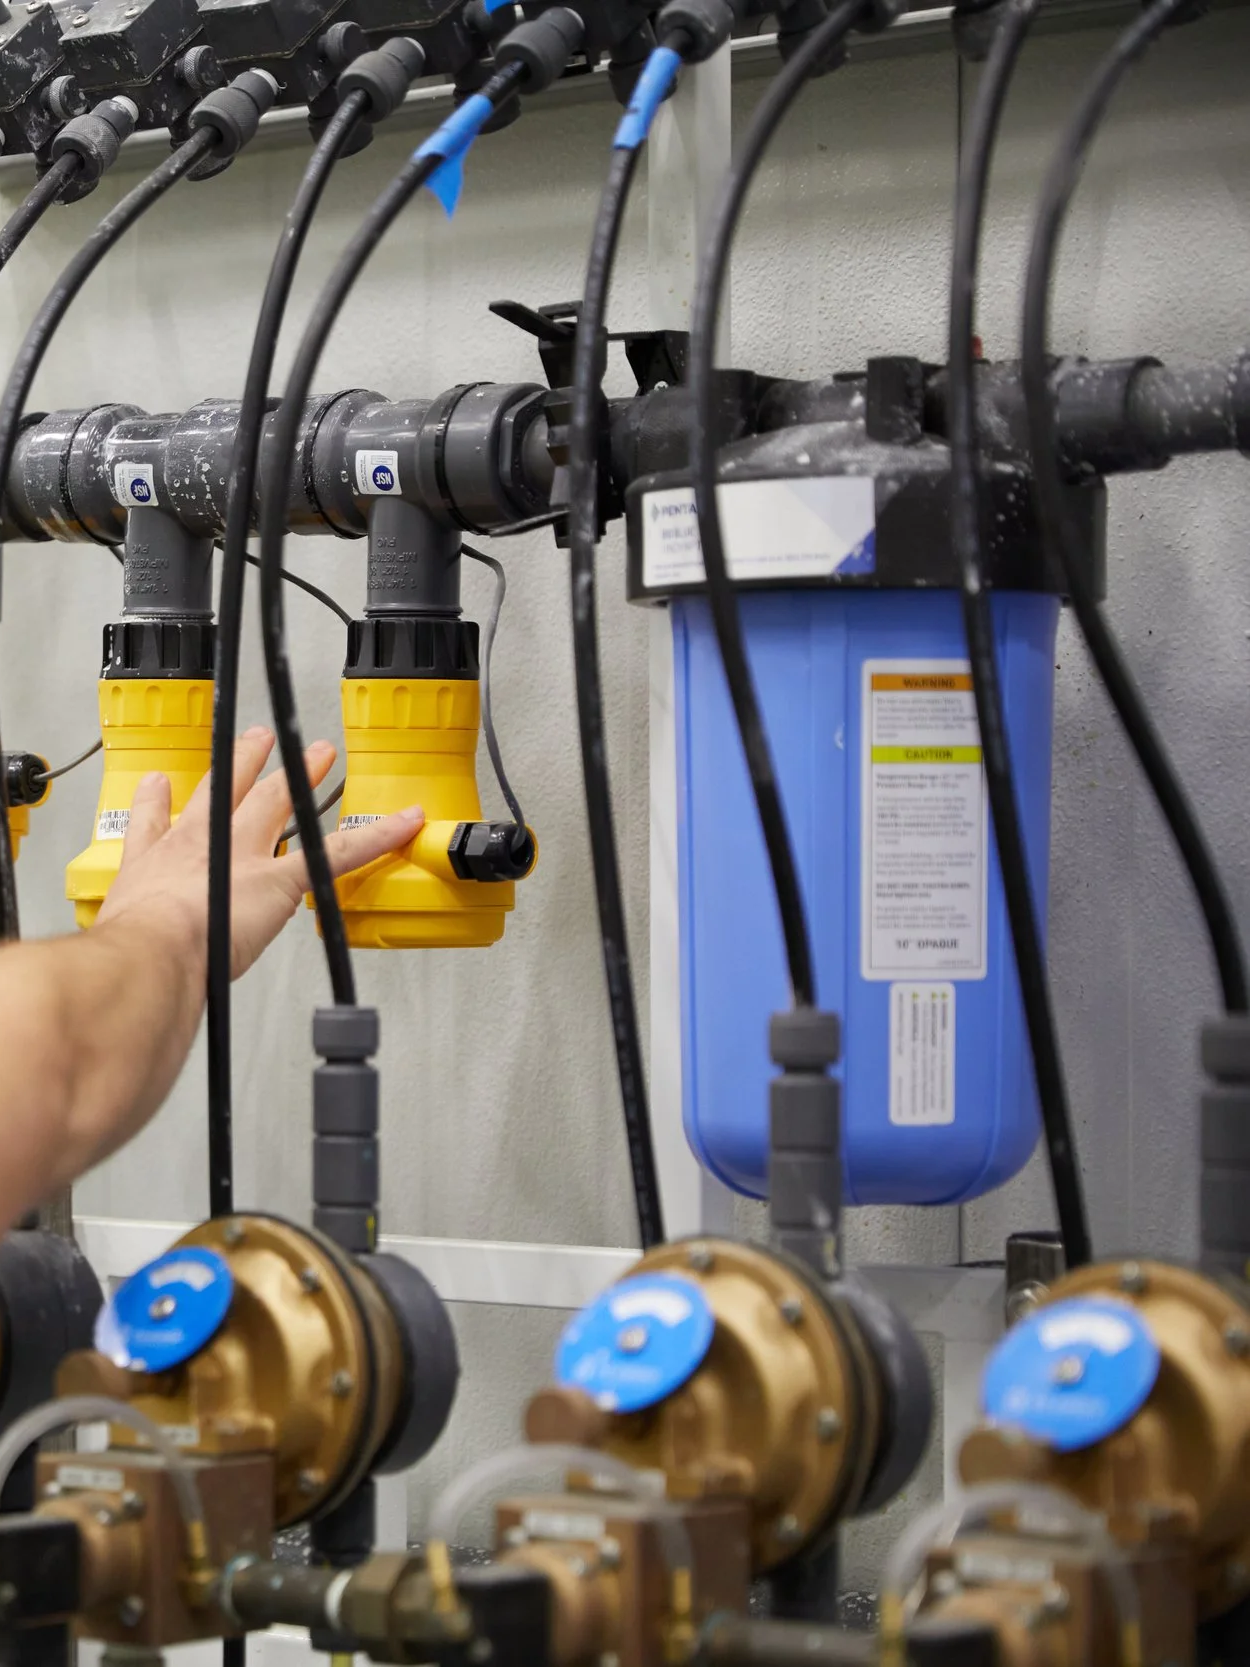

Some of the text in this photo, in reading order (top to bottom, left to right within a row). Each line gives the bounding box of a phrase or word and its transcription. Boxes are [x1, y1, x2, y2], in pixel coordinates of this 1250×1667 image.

[376, 472, 392, 485] NSF
[134, 484, 149, 497] NSF
[661, 502, 698, 517] PENTA
[903, 678, 956, 689] WARNING
[905, 749, 953, 760] CAUTION
